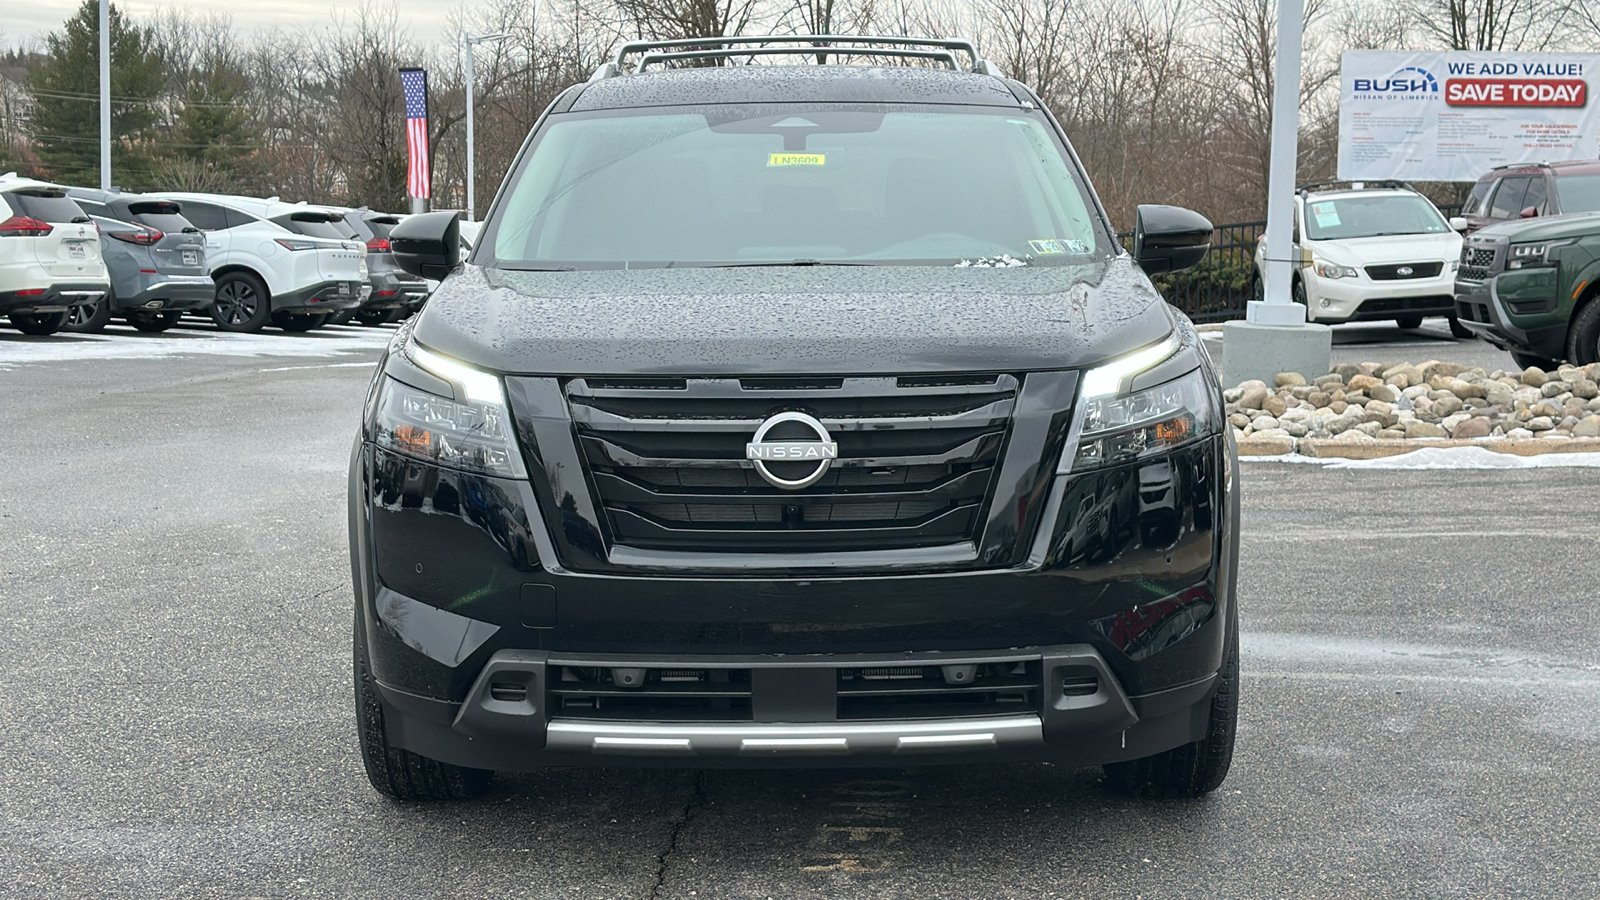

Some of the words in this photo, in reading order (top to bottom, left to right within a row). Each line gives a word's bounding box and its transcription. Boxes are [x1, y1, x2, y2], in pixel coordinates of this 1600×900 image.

[1448, 63, 1475, 75] WE
[1480, 63, 1518, 75] ADD
[1522, 63, 1583, 76] VALUE!
[1354, 79, 1427, 92] BUSH
[1449, 84, 1504, 101] SAVE
[1509, 85, 1582, 103] TODAY
[749, 445, 836, 458] NISSAN
